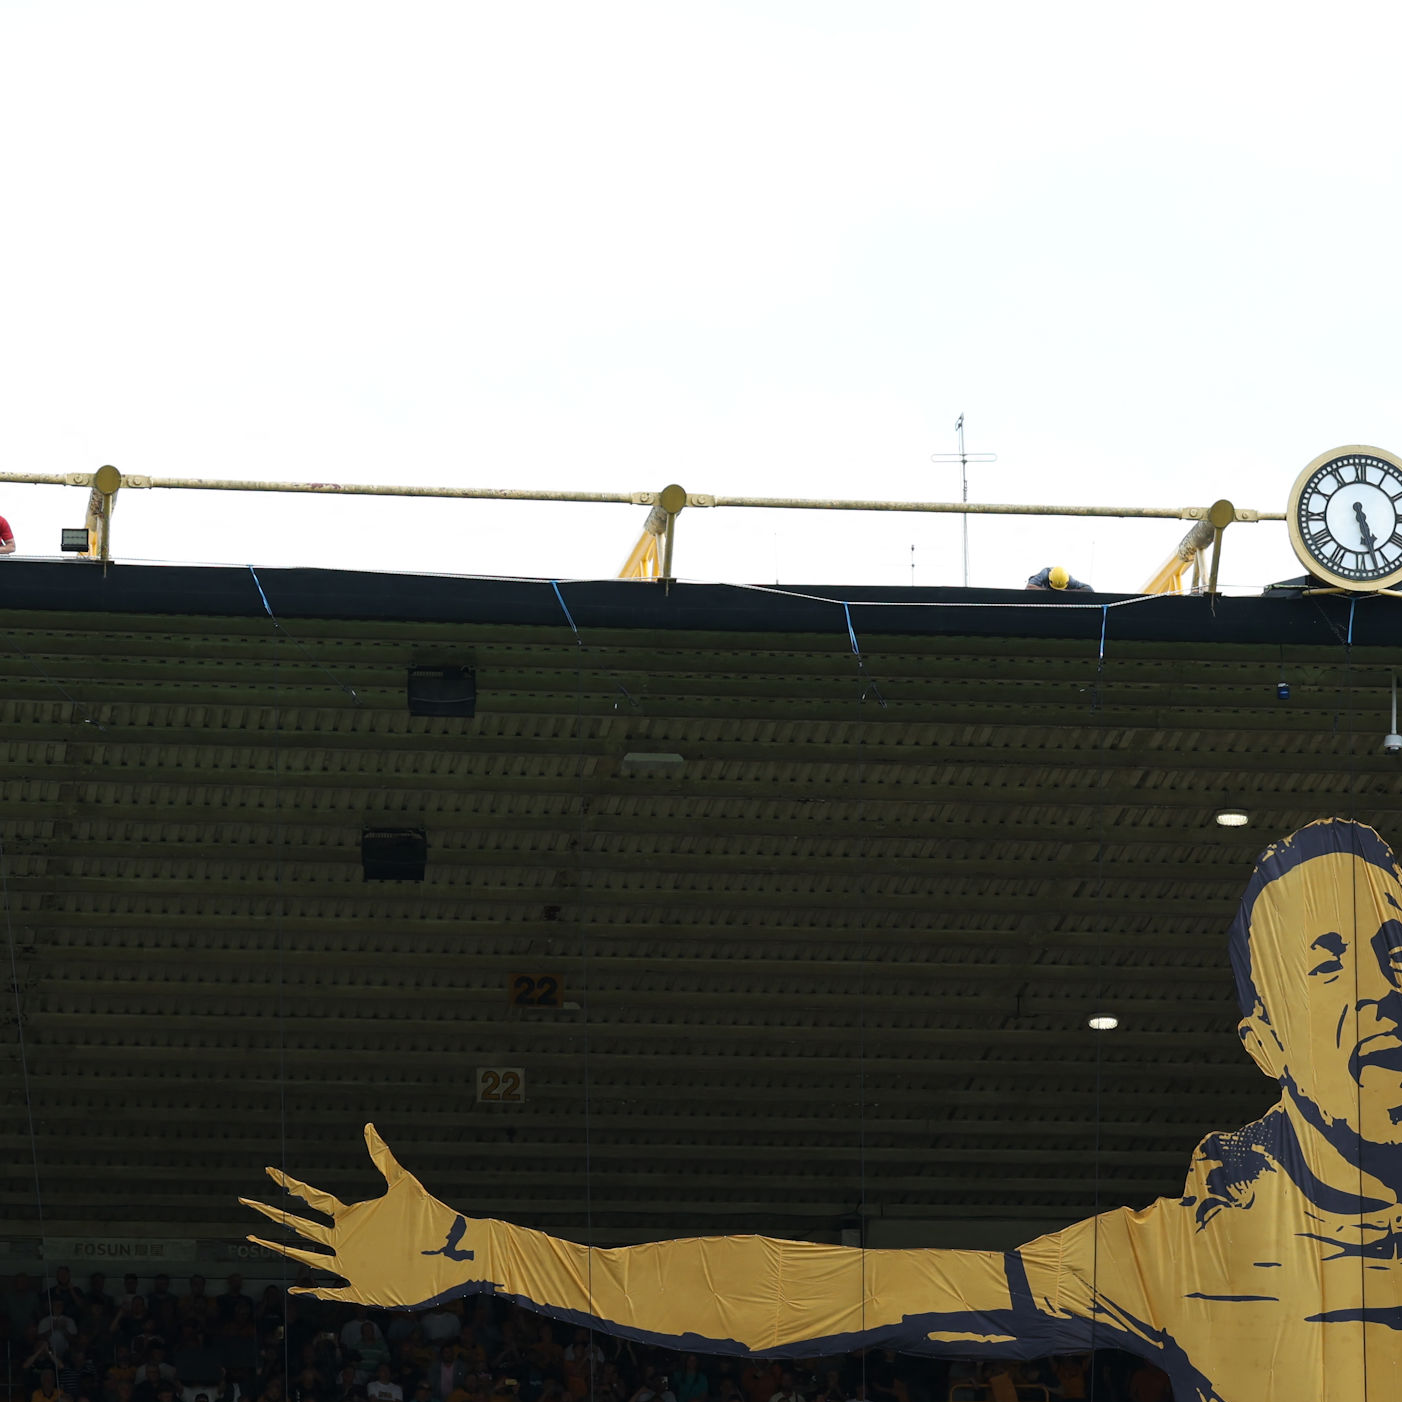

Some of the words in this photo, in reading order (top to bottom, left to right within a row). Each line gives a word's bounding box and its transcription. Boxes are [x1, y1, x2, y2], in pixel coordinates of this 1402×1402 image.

[514, 977, 557, 1005] 22
[481, 1071, 521, 1100] 22
[75, 1243, 130, 1256] FOSUN
